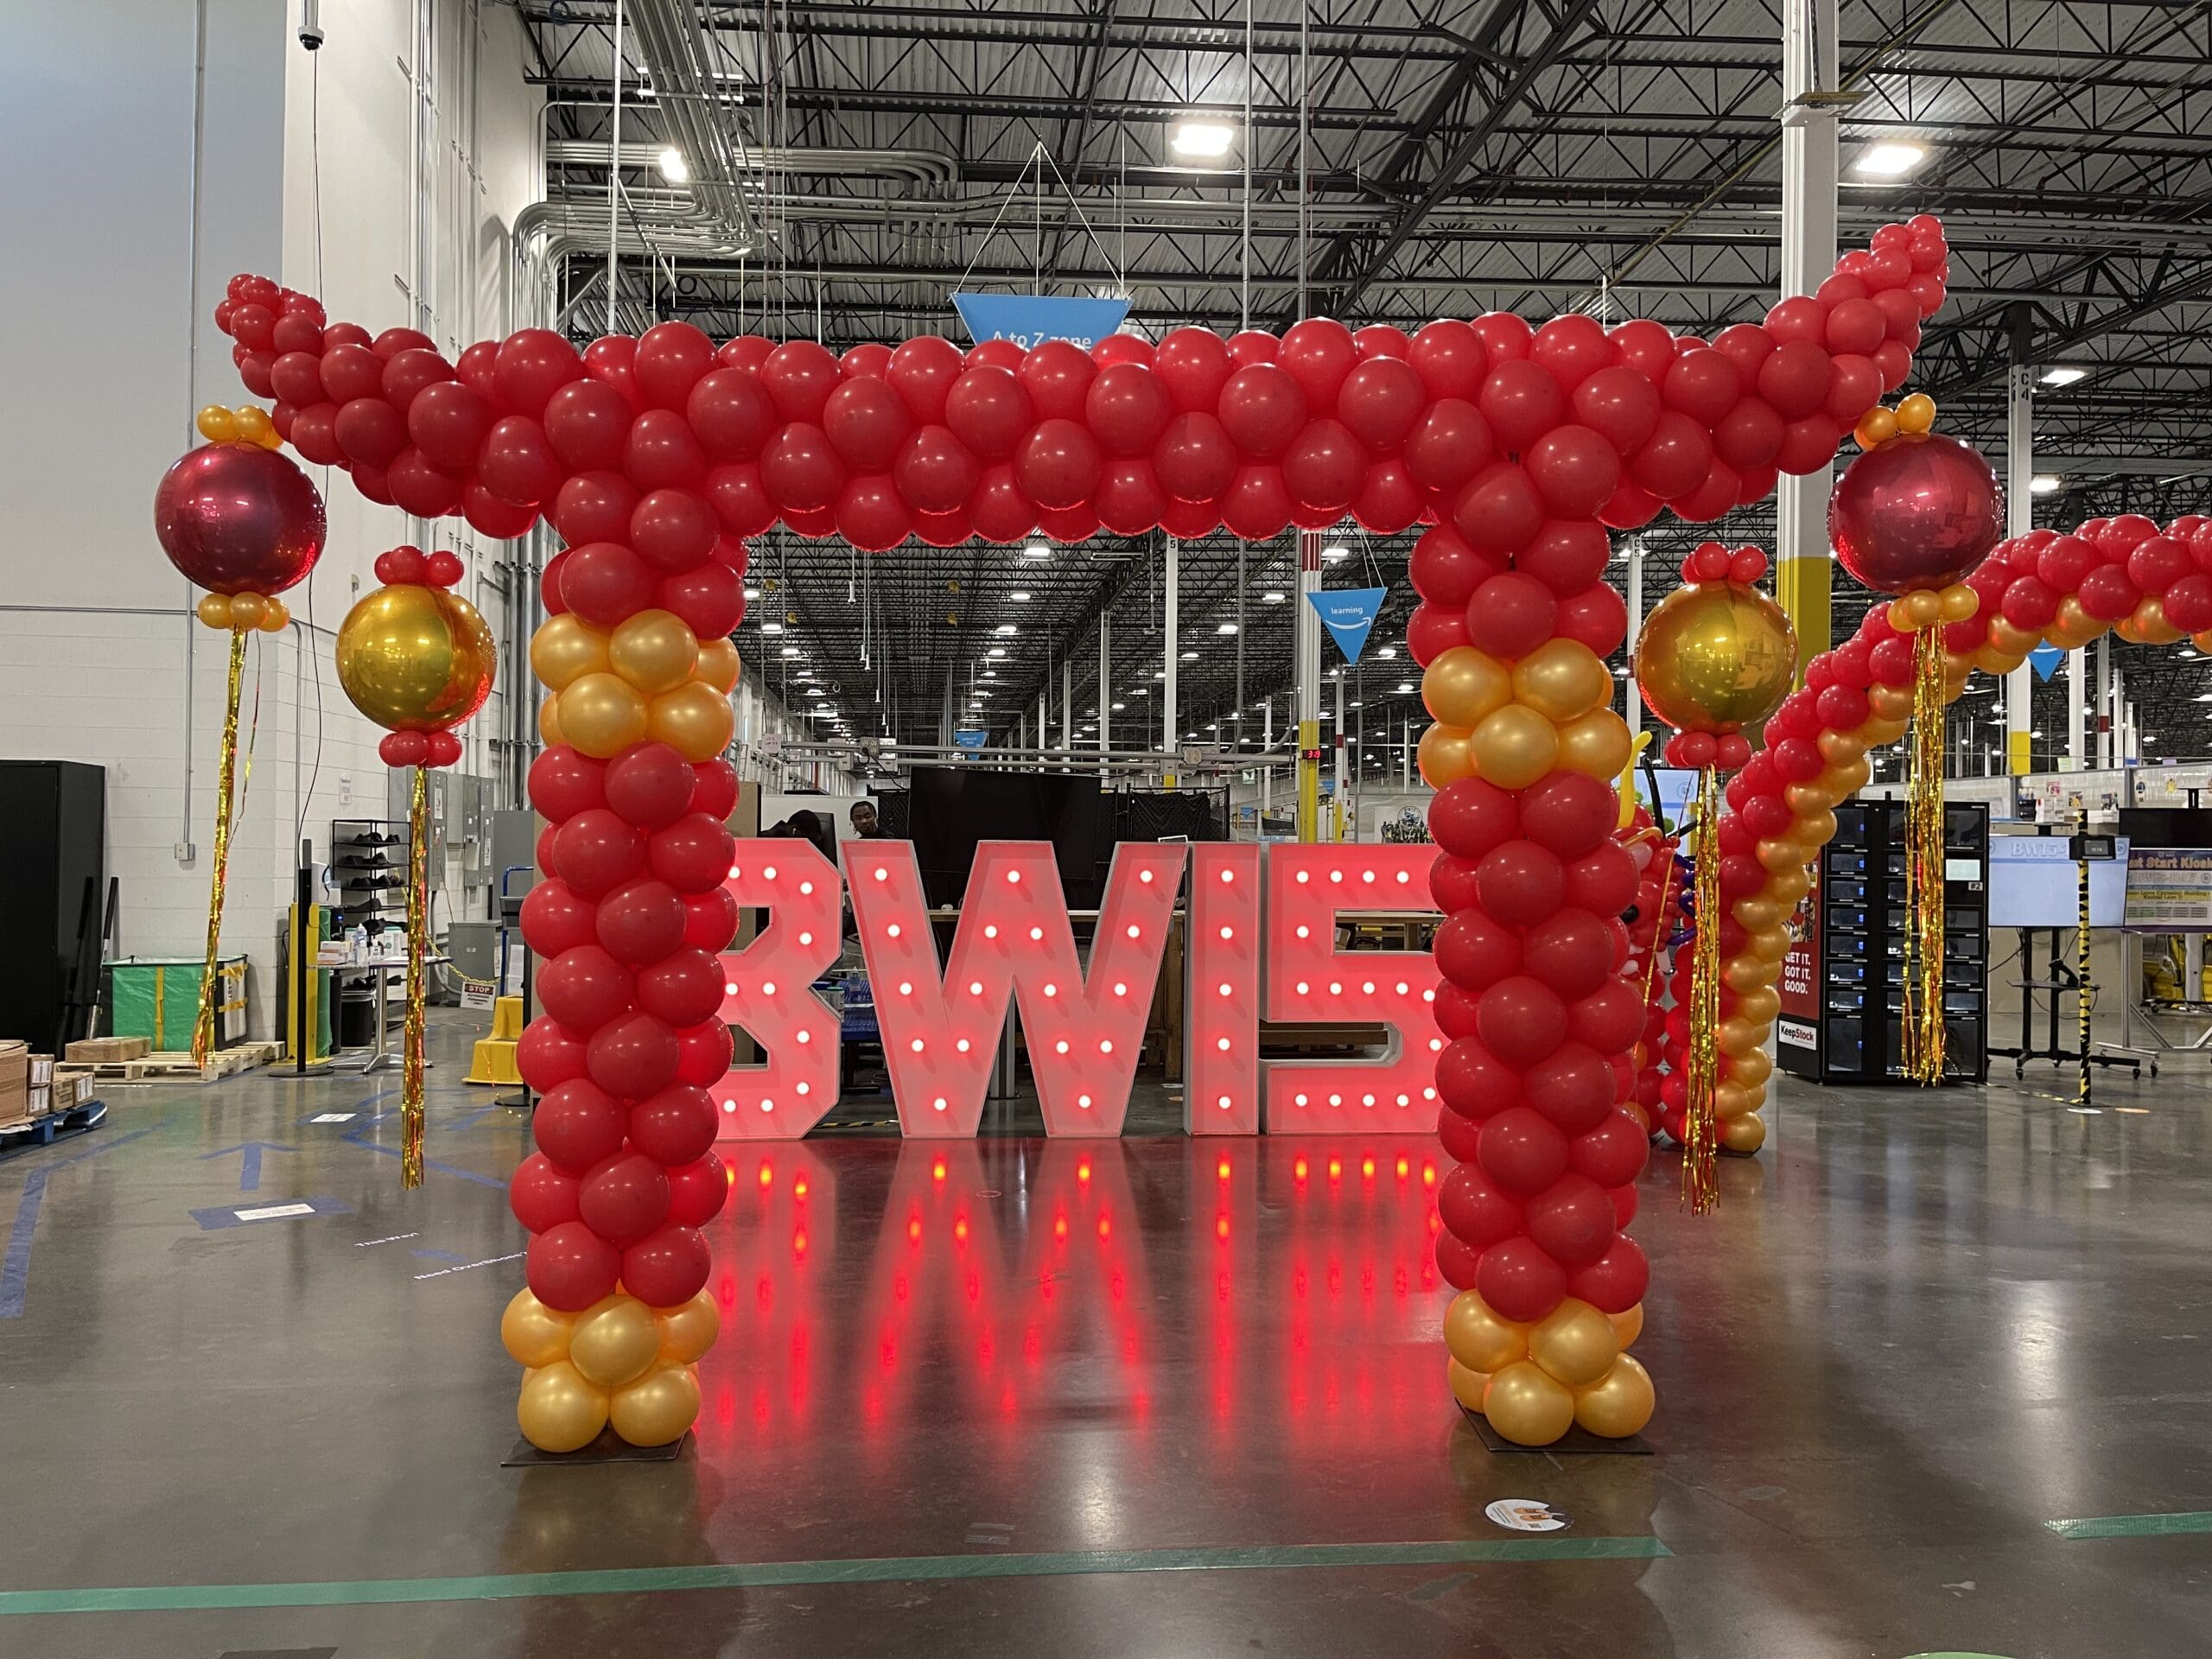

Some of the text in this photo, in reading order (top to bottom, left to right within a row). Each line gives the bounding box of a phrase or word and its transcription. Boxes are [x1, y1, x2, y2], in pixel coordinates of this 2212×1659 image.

[1009, 332, 1027, 347] to
[1033, 332, 1045, 347] Z
[1050, 336, 1092, 349] ne
[1784, 951, 1811, 965] GET IT.
[1784, 965, 1811, 981] GOT IT.
[1784, 980, 1808, 995] GOOD.
[1781, 1025, 1814, 1041] KeepStock
